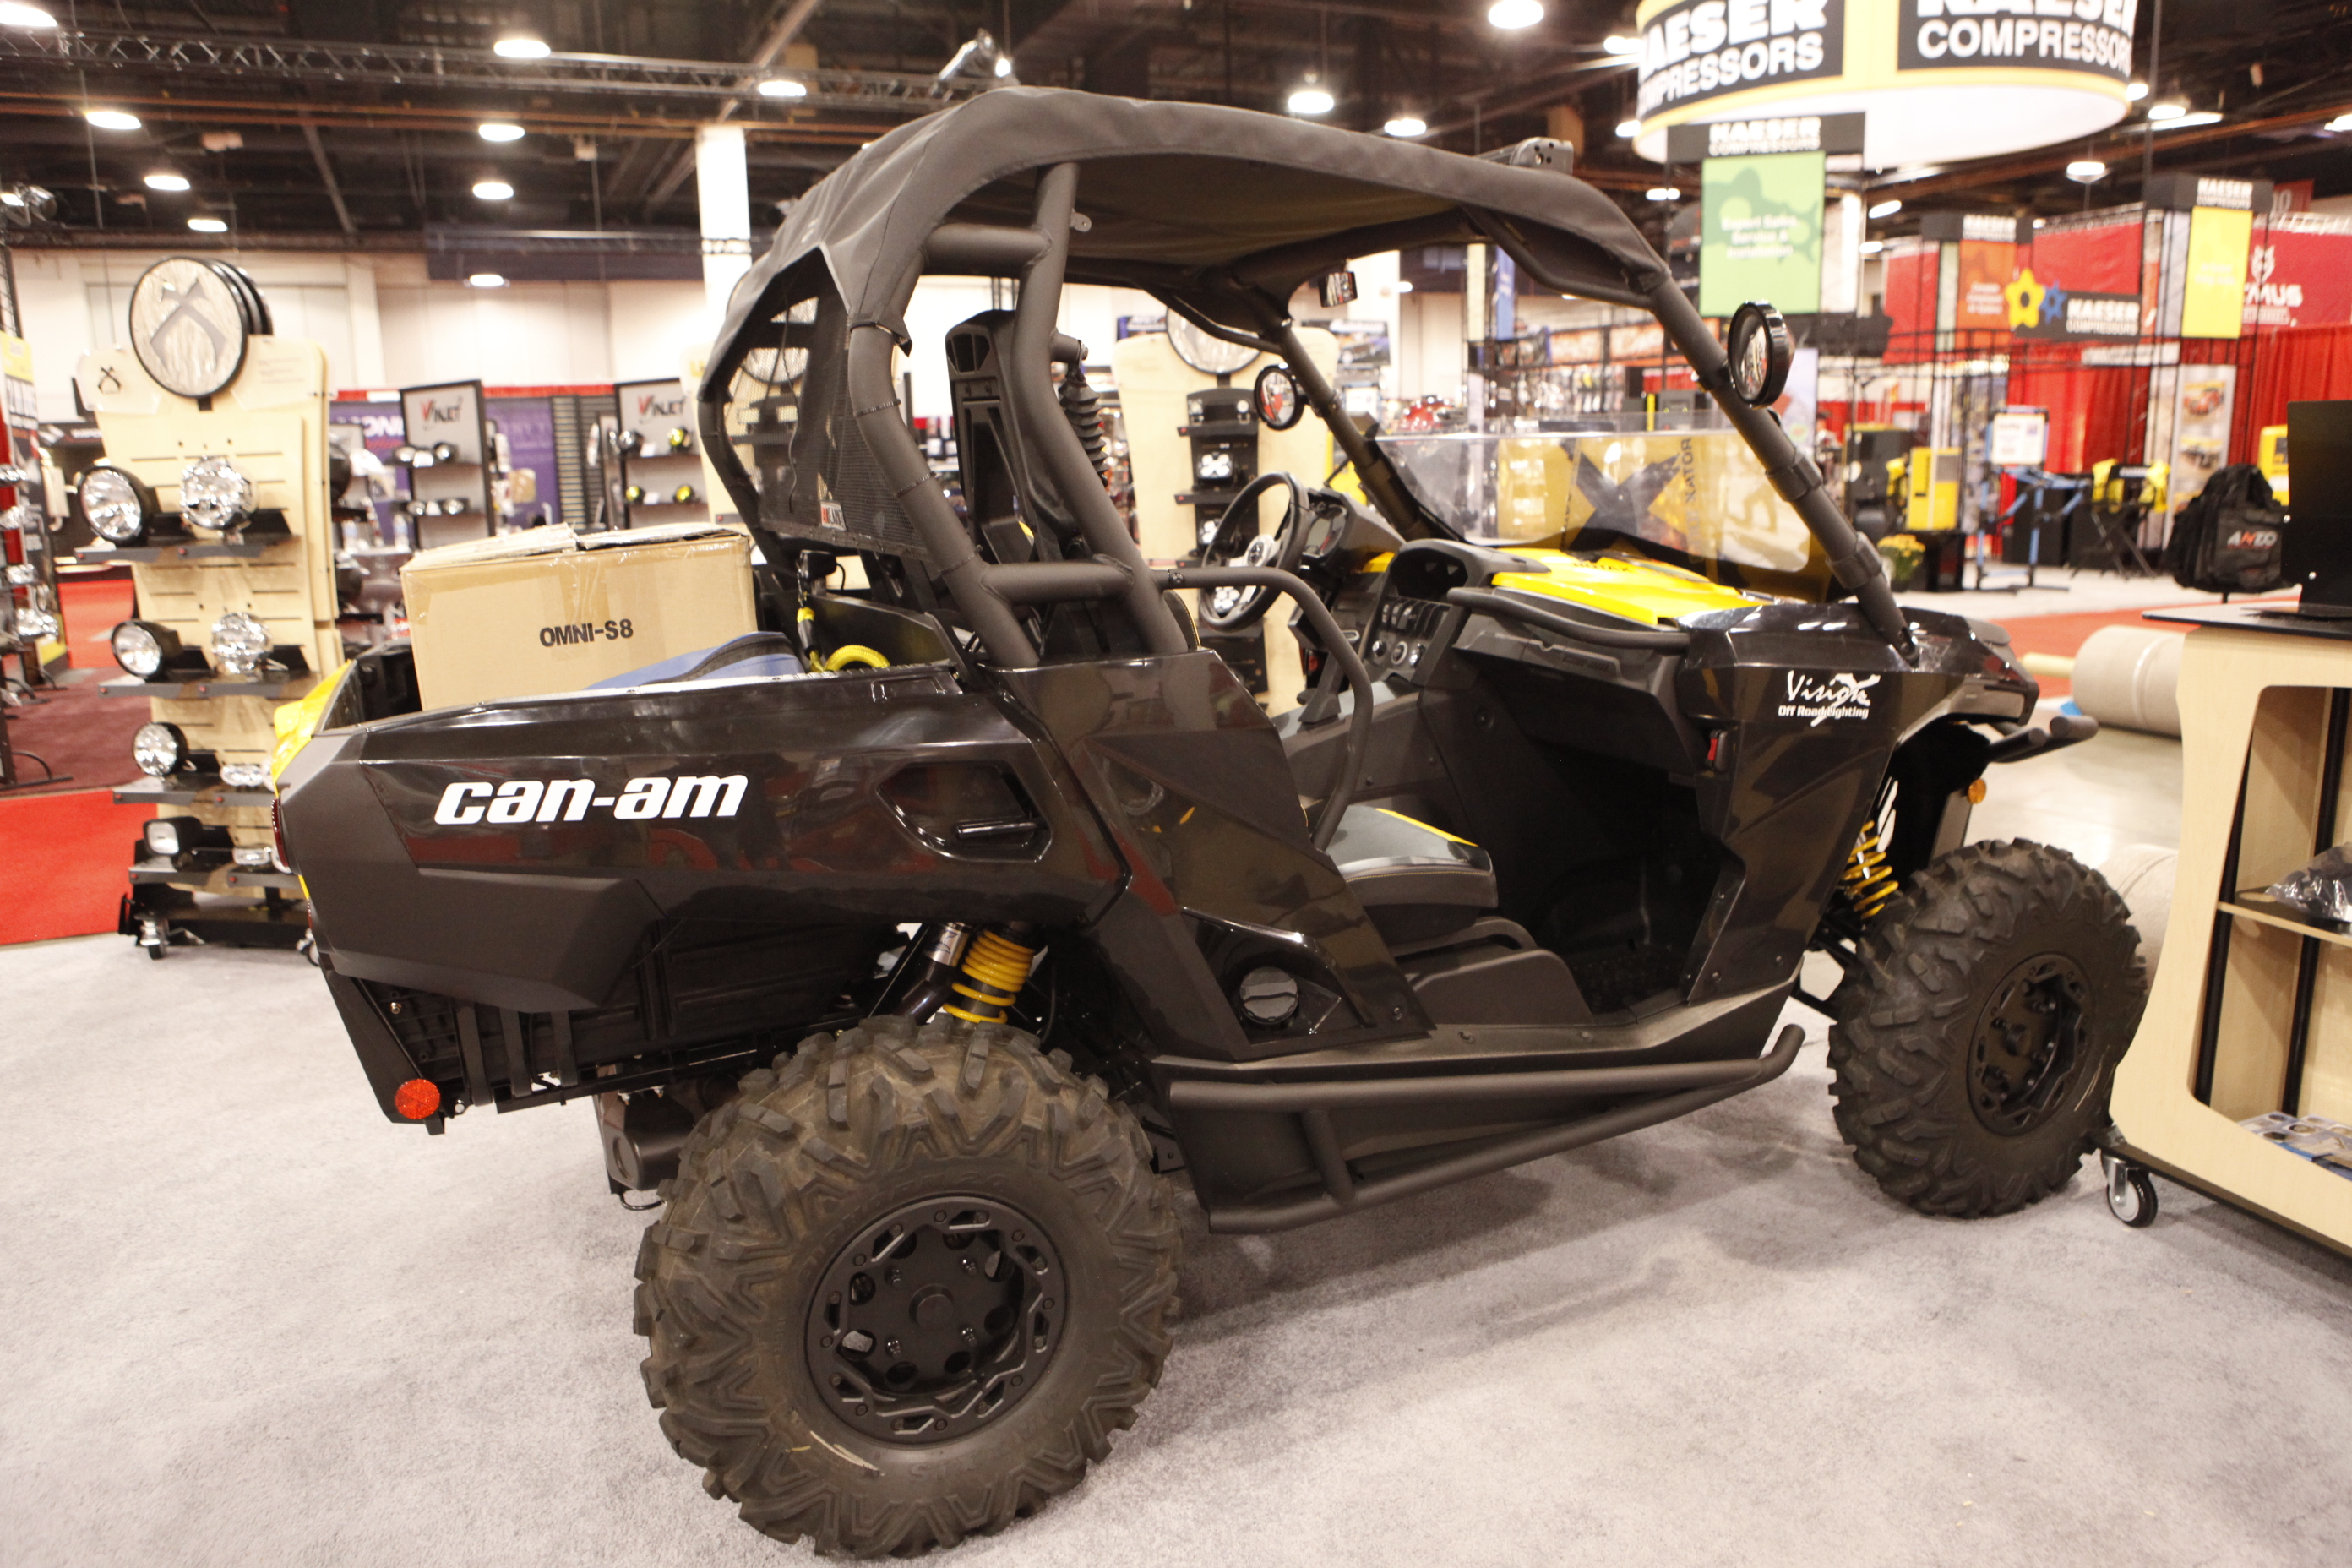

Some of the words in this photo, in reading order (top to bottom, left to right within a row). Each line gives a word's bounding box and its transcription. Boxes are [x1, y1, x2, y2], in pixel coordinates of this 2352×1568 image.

[1710, 117, 1821, 141] KAESER
[2067, 298, 2140, 322] KAESER
[540, 618, 634, 647] OMNI-S8
[1778, 705, 1796, 716] Off
[434, 775, 749, 825] can-am
